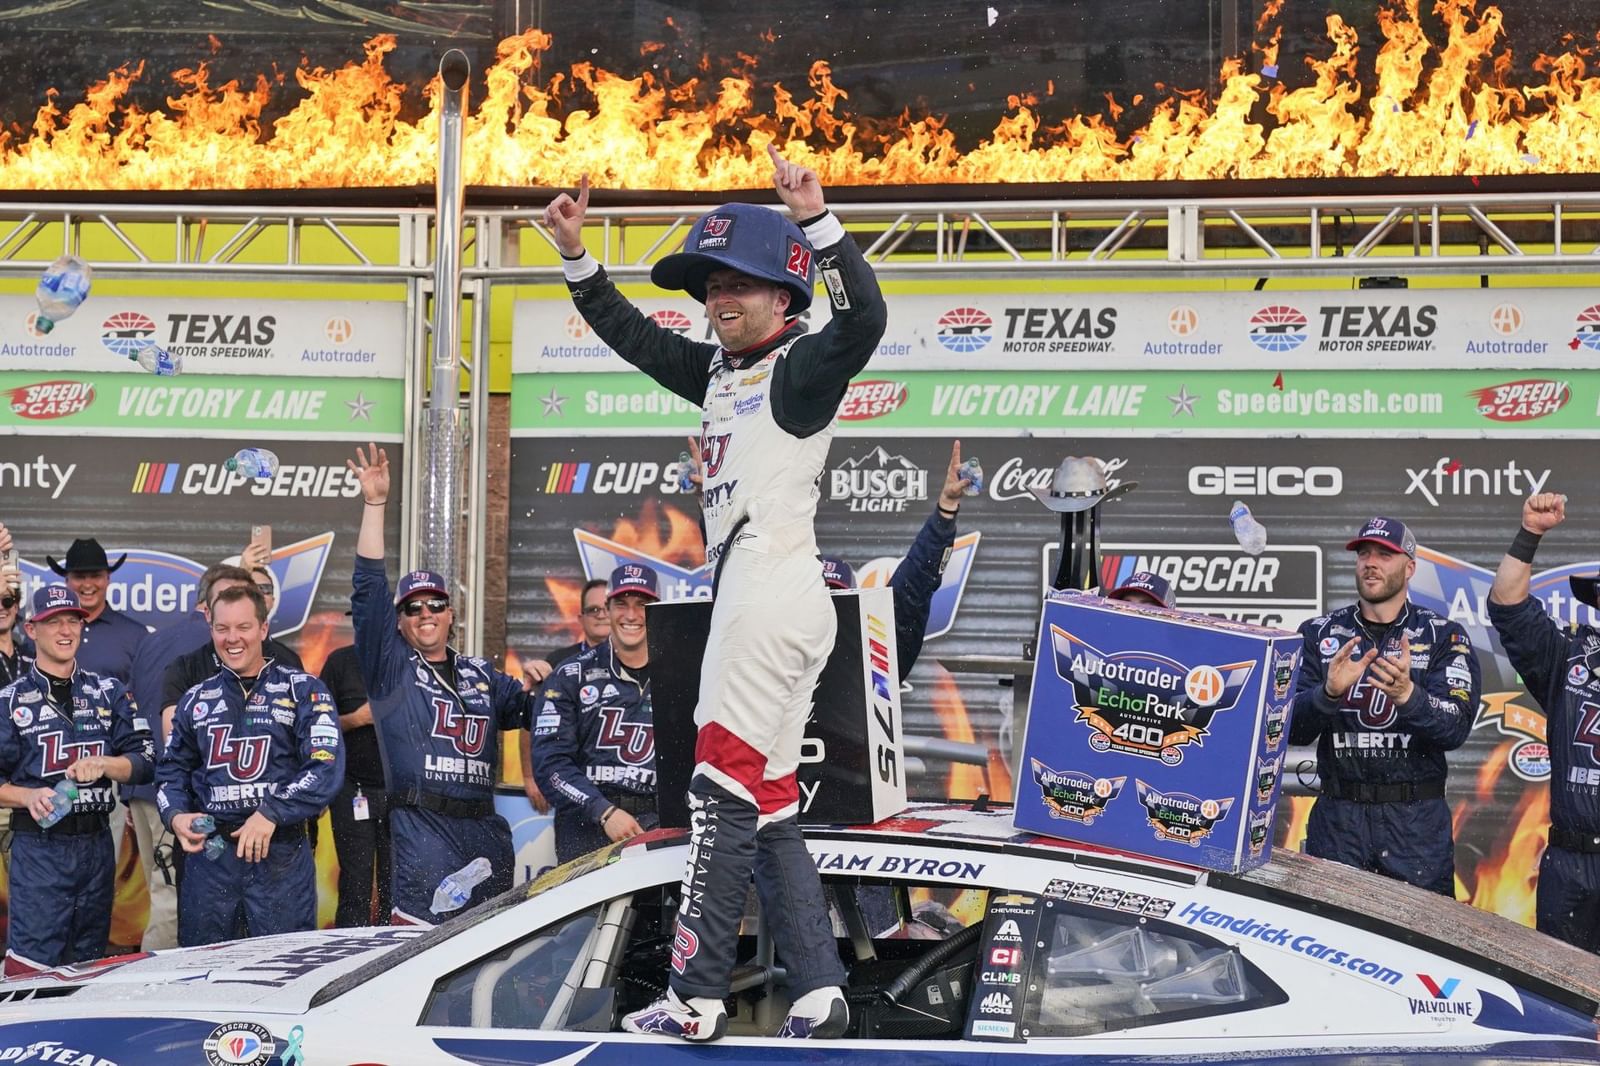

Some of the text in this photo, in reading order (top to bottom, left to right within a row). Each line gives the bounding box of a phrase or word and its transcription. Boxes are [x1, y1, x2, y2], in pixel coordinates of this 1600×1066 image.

[786, 243, 811, 281] 24
[167, 314, 276, 345] TEXAS
[1003, 307, 1117, 339] TEXAS
[1319, 305, 1438, 338] TEXAS
[2, 343, 76, 357] Autotrader
[167, 346, 271, 358] MOTOR SPEEDWAY
[1003, 341, 1112, 353] MOTOR SPEEDWAY
[1144, 341, 1223, 355] Autotrader
[1319, 340, 1432, 352] MOTOR SPEEDWAY
[1466, 340, 1548, 354] Autotrader
[302, 349, 376, 363] Autotrader
[26, 383, 93, 403] SPEEDY
[845, 382, 906, 404] SPEEDY
[930, 385, 1147, 416] VICTORY LANE
[1495, 381, 1569, 403] SPEEDY
[27, 400, 87, 416] CA$H
[118, 386, 326, 420] VICTORY LANE
[585, 390, 700, 416] SpeedyC
[1218, 389, 1443, 416] SpeedyCash.com
[1497, 400, 1561, 416] CA$H
[182, 463, 247, 495] CUP
[593, 463, 659, 494] CUP
[830, 469, 928, 500] BUSCH
[1188, 466, 1343, 496] GEICO
[1405, 457, 1552, 507] xfinity
[849, 498, 907, 512] LIGHT
[620, 577, 648, 585] LIBERTY
[1134, 556, 1280, 593] NASCAR
[409, 581, 436, 590] LIBERTY
[46, 600, 74, 608] LIBERTY
[1070, 654, 1181, 691] Autotrader
[1097, 687, 1187, 721] EchoPark
[431, 697, 490, 757] LU
[1119, 713, 1161, 725] AUTOMOTIVE
[1112, 723, 1164, 747] 400
[207, 723, 271, 783] LU
[425, 754, 491, 778] LIBERTY
[1041, 772, 1093, 790] Autotrader
[1053, 789, 1095, 805] EchoPark
[1145, 793, 1199, 812] Autotrader
[1061, 804, 1084, 816] 400
[1159, 809, 1202, 826] EchoPark
[1167, 826, 1191, 837] 400
[690, 795, 719, 919] UNIVERSITY
[878, 856, 986, 880] BYRON
[991, 907, 1036, 915] CHEVROLET
[991, 949, 1019, 965] CI
[981, 971, 1021, 983] CLIMB
[981, 992, 1013, 1008] MAC
[1408, 997, 1473, 1017] VALVOLINE
[980, 1007, 1013, 1015] TOOLS
[215, 1023, 269, 1040] NASCAR 75TH
[681, 1021, 699, 1036] 24
[977, 1024, 1009, 1033] SIEMENS
